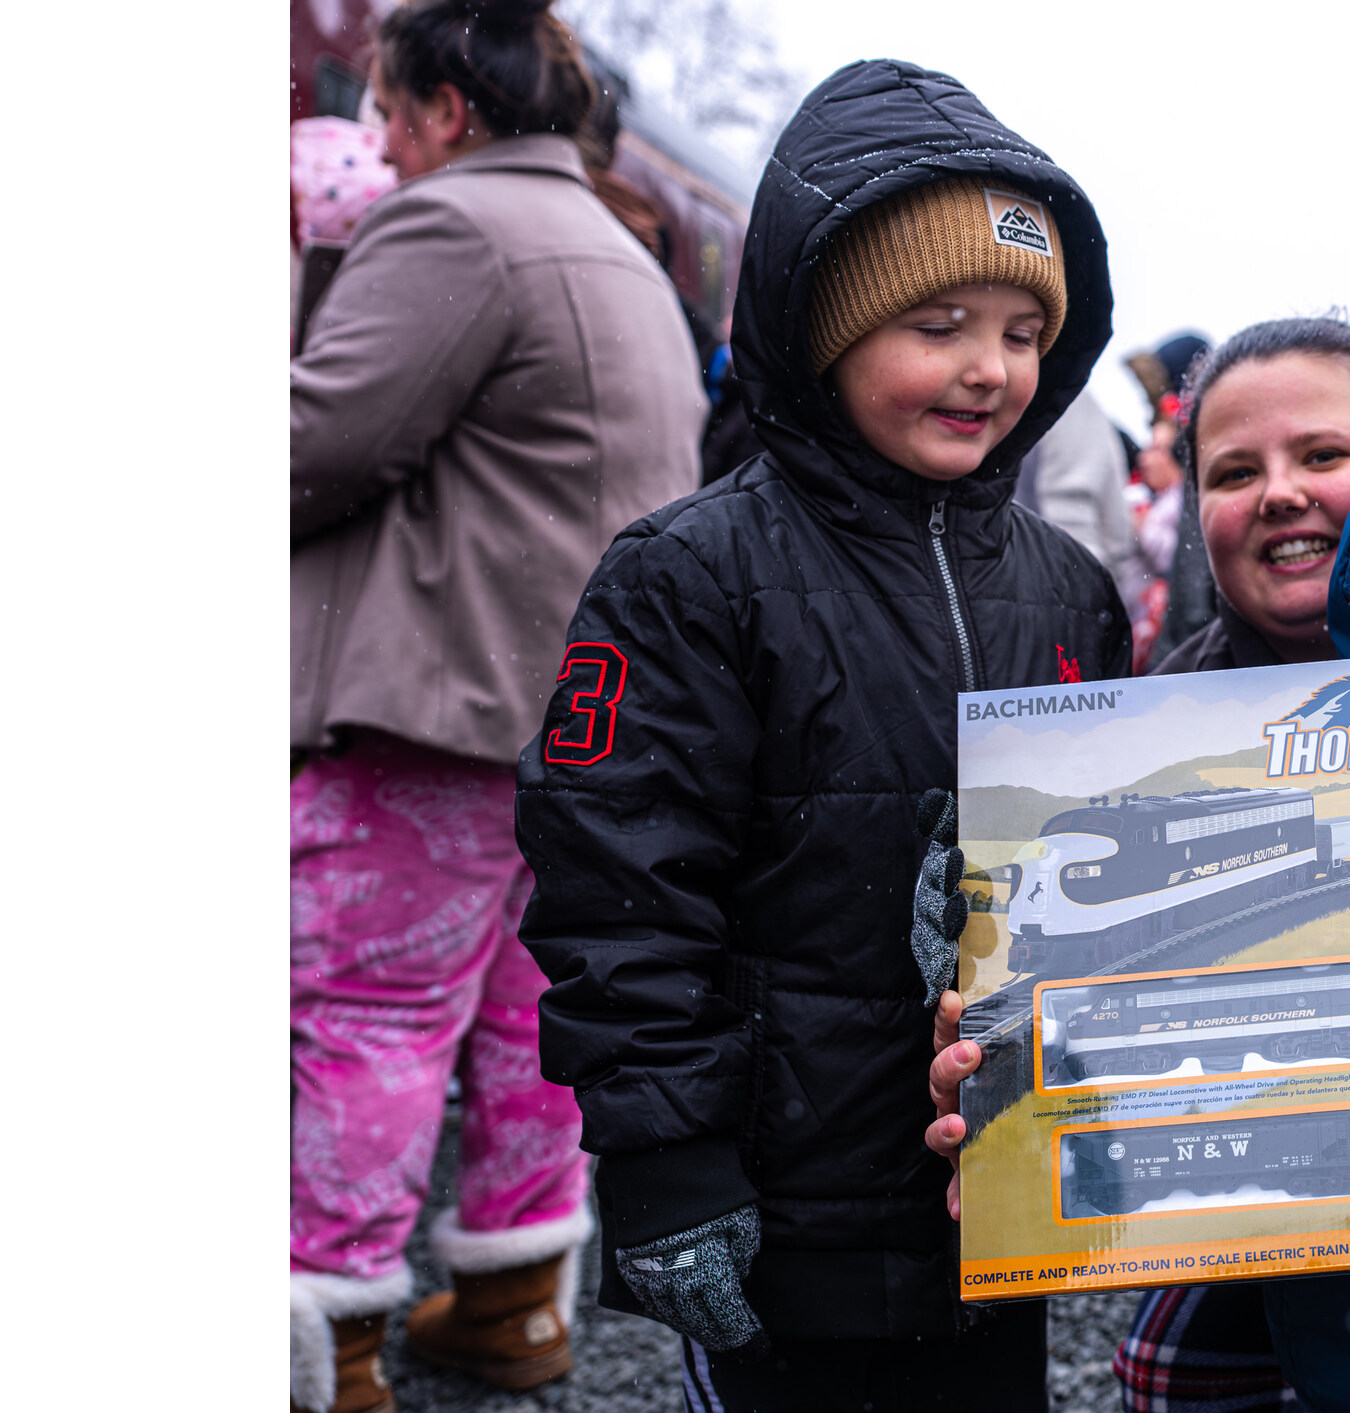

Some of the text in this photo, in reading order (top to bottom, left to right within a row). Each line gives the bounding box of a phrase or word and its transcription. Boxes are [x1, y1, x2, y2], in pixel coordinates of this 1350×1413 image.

[1010, 229, 1046, 249] Columbia
[545, 641, 628, 766] 3
[1221, 852, 1251, 871] NORFOLK
[1253, 842, 1288, 862] SOUTHERN
[1092, 1011, 1118, 1020] 4270
[1165, 1008, 1315, 1030] NS NORFOLK SOUTHERN
[1032, 1109, 1070, 1118] Locomotora
[1130, 1100, 1161, 1111] operación
[1197, 1095, 1222, 1104] tracción
[1307, 1085, 1337, 1094] delantera
[1067, 1094, 1119, 1106] Smooth-Running
[1170, 1086, 1205, 1095] Locomotive
[1224, 1082, 1255, 1091] All-Wheel
[1289, 1077, 1322, 1086] Operating
[1172, 1135, 1200, 1144] NORFOLK
[1221, 1131, 1252, 1140] WESTERN
[1177, 1139, 1248, 1161] N & W
[964, 1268, 1033, 1286] COMPLETE
[1038, 1266, 1066, 1279] AND
[1072, 1257, 1170, 1277] READY-TO-RUN
[1175, 1255, 1195, 1268] HO
[1199, 1252, 1240, 1266] SCALE
[1244, 1246, 1305, 1263] ELECTRIC
[1308, 1243, 1349, 1257] TRAIN
